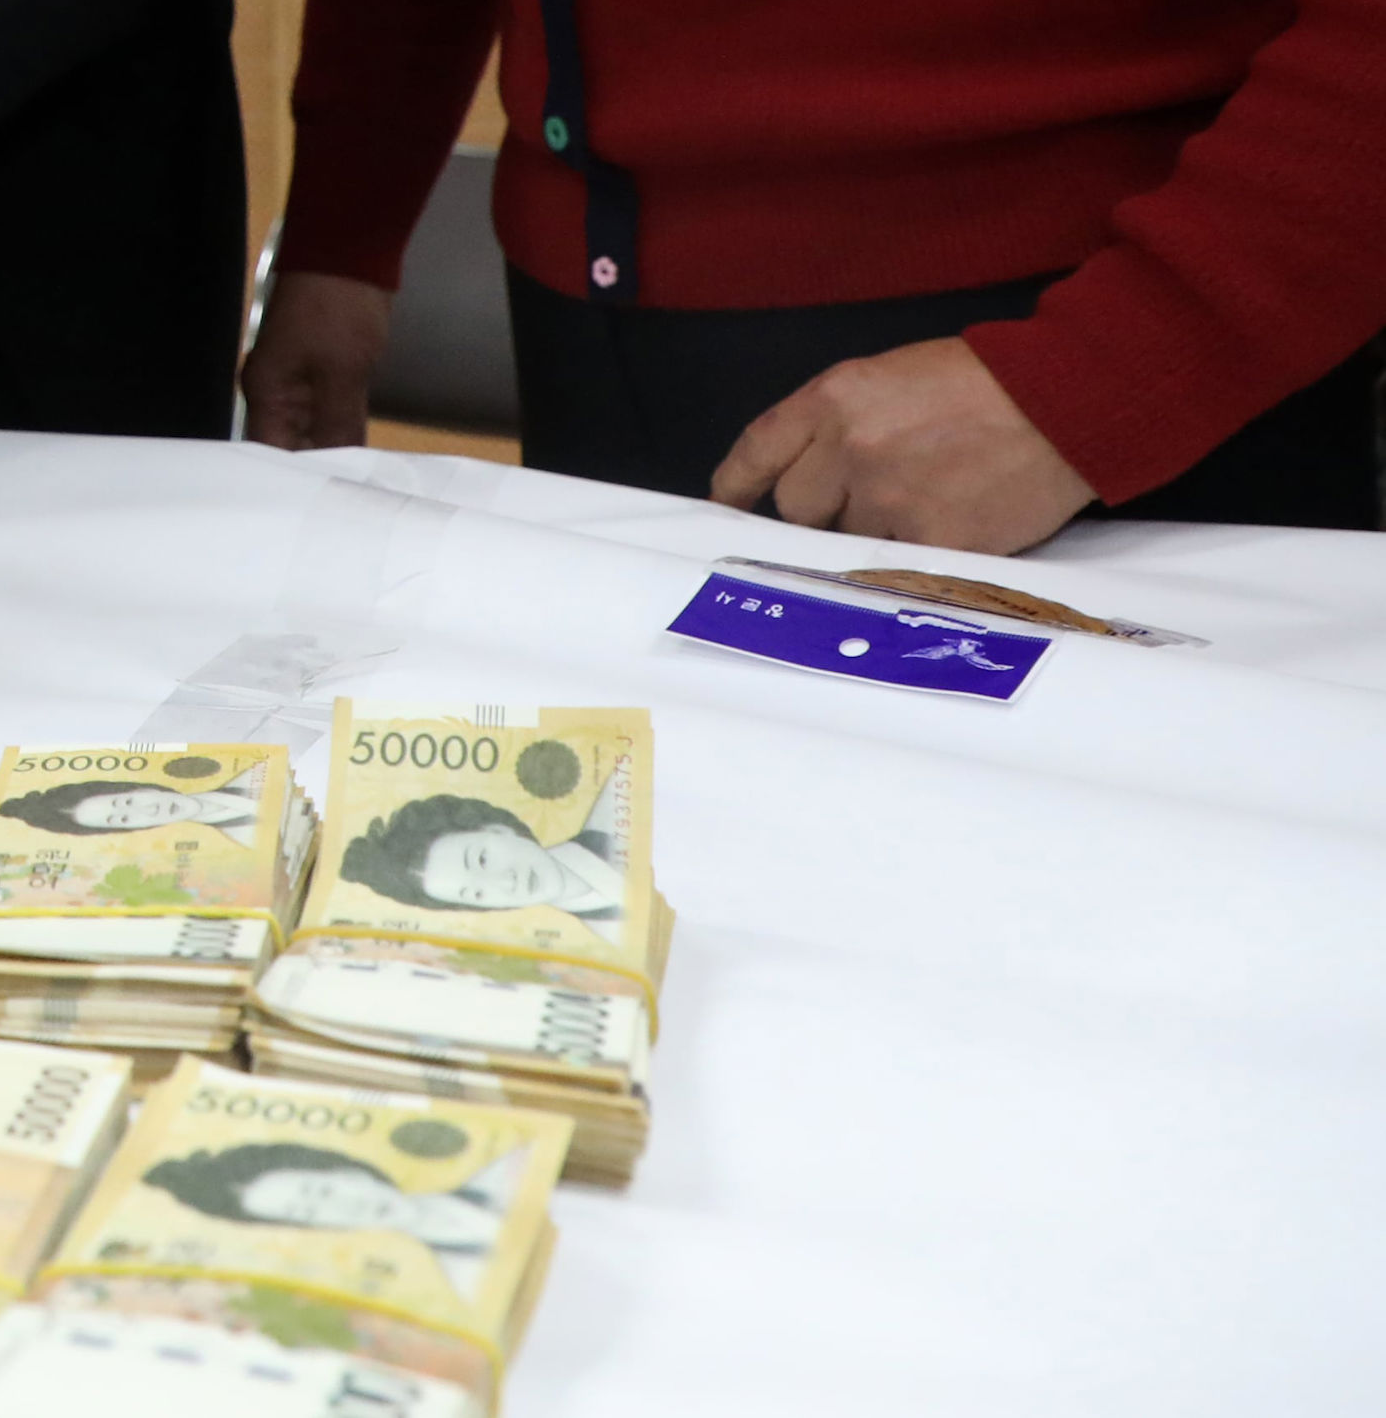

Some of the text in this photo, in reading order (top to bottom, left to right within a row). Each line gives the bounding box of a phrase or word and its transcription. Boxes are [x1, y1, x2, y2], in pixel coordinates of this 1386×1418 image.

[12, 756, 149, 772] 50000
[348, 731, 500, 773] 50000
[185, 1085, 372, 1136] 50000
